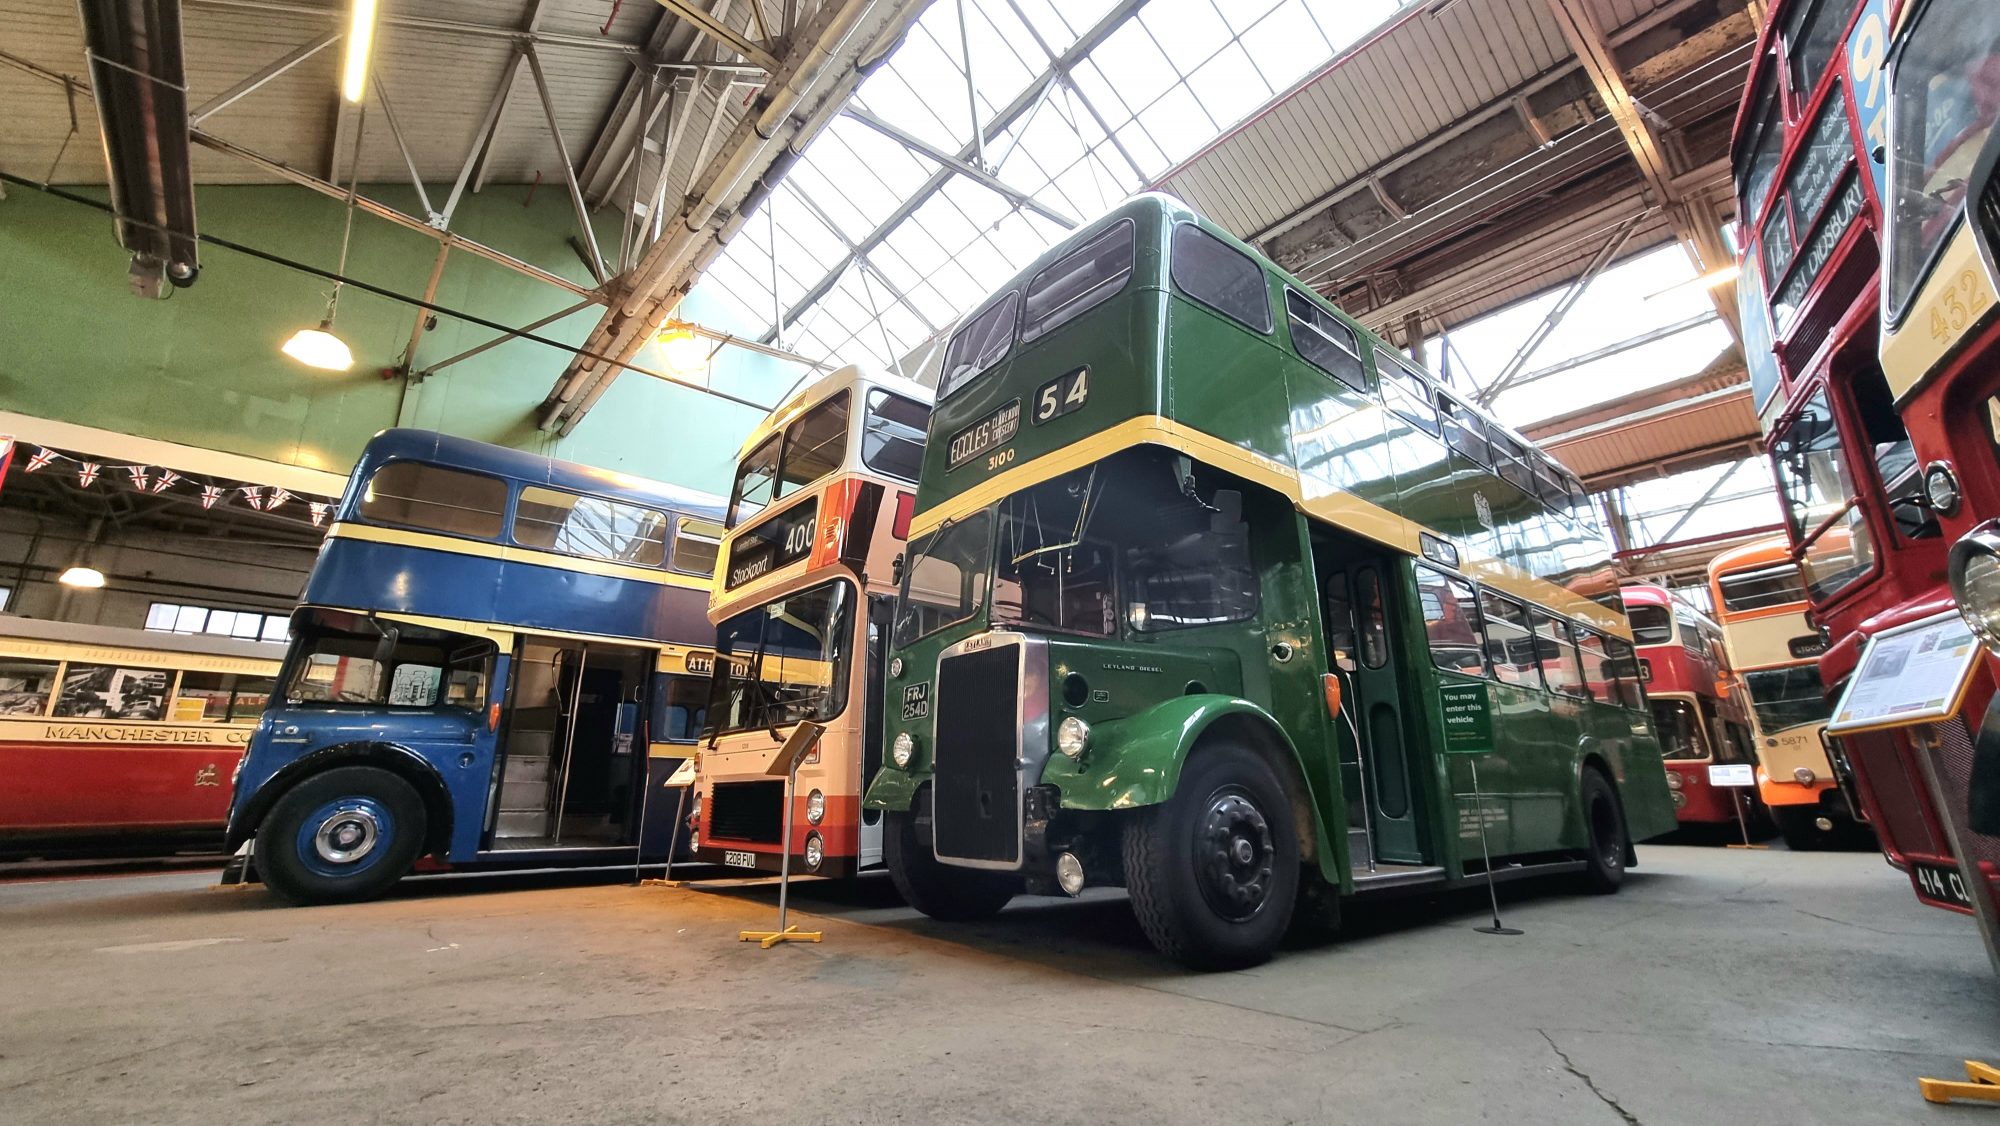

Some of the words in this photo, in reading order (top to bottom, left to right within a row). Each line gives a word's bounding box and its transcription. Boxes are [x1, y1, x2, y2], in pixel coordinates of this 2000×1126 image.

[1808, 174, 1863, 275] DIDSBURY
[1931, 269, 1987, 344] 432
[1039, 369, 1088, 420] 54
[951, 421, 989, 465] ECCLES
[988, 448, 1015, 471] 3100
[731, 554, 768, 587] Stockport
[1103, 663, 1135, 671] LEYLAND
[907, 684, 926, 702] FRJ
[903, 701, 928, 718] 254D
[1467, 703, 1482, 711] this
[1447, 716, 1474, 724] vehicle
[46, 726, 212, 743] MANCHESTER
[1781, 736, 1808, 746] 5871
[742, 853, 755, 867] FVU
[1918, 867, 1946, 897] 414
[1948, 872, 1971, 902] CL
